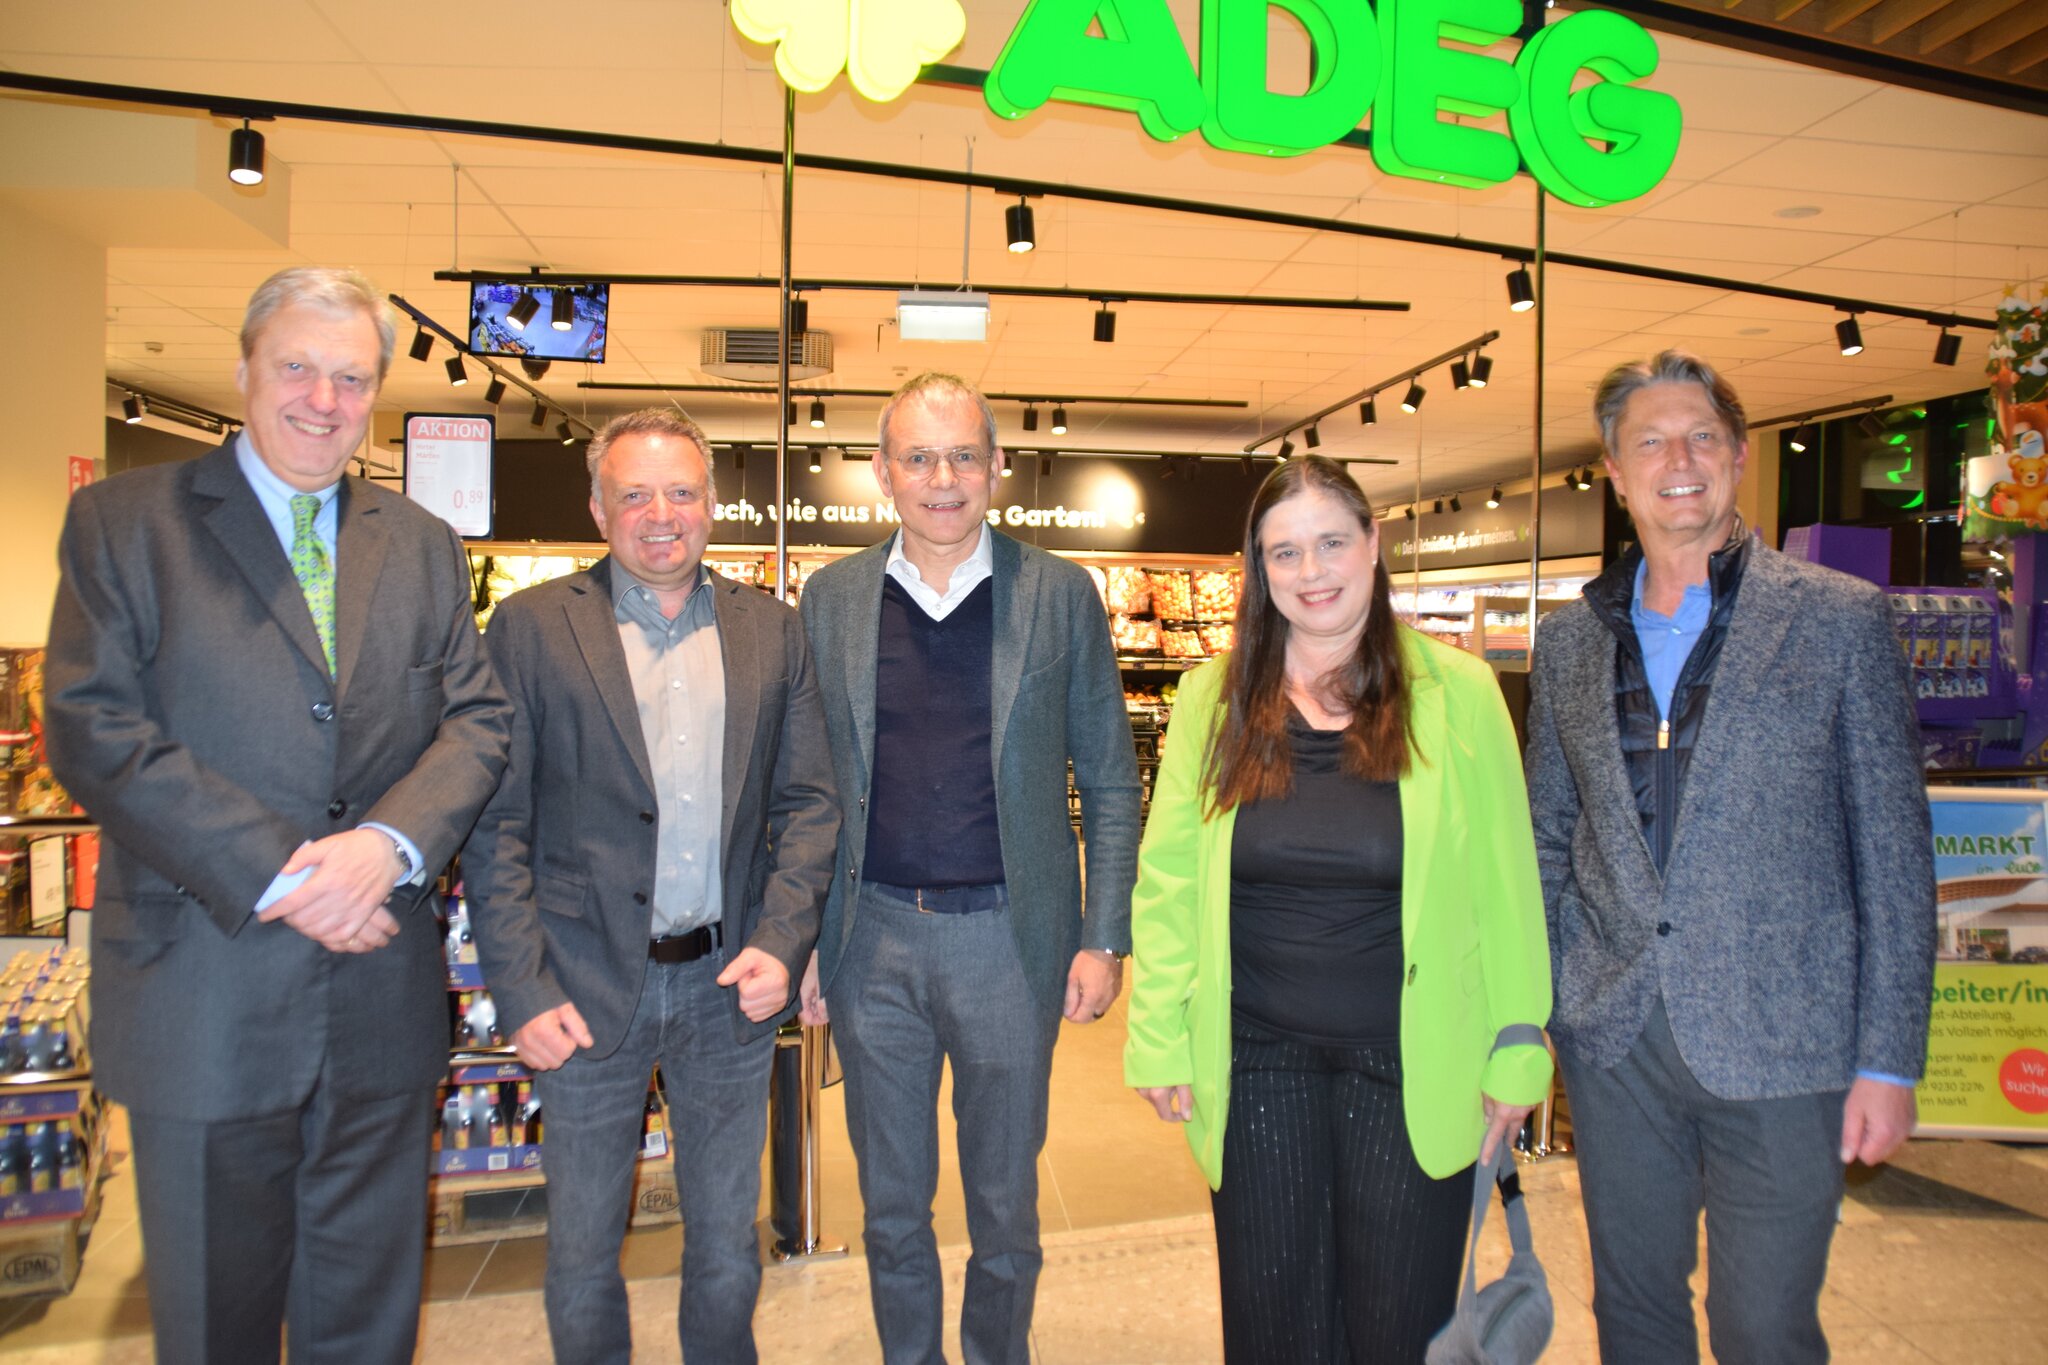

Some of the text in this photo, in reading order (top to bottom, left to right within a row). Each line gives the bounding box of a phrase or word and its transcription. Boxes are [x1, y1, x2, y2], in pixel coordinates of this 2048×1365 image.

[985, 0, 1682, 206] ADEG
[416, 421, 485, 438] AKTION
[712, 498, 763, 526] sch,
[821, 503, 870, 523] aus
[1934, 836, 2035, 856] MARKT
[1931, 979, 2048, 1005] beiter/in
[1932, 1009, 2015, 1023] st-Abteilung,
[1946, 1026, 1991, 1038] Vollzeit
[1956, 1052, 1978, 1063] Mail
[2021, 1060, 2046, 1077] Wir
[646, 1192, 676, 1208] EPAL
[13, 1260, 49, 1276] EPAL
